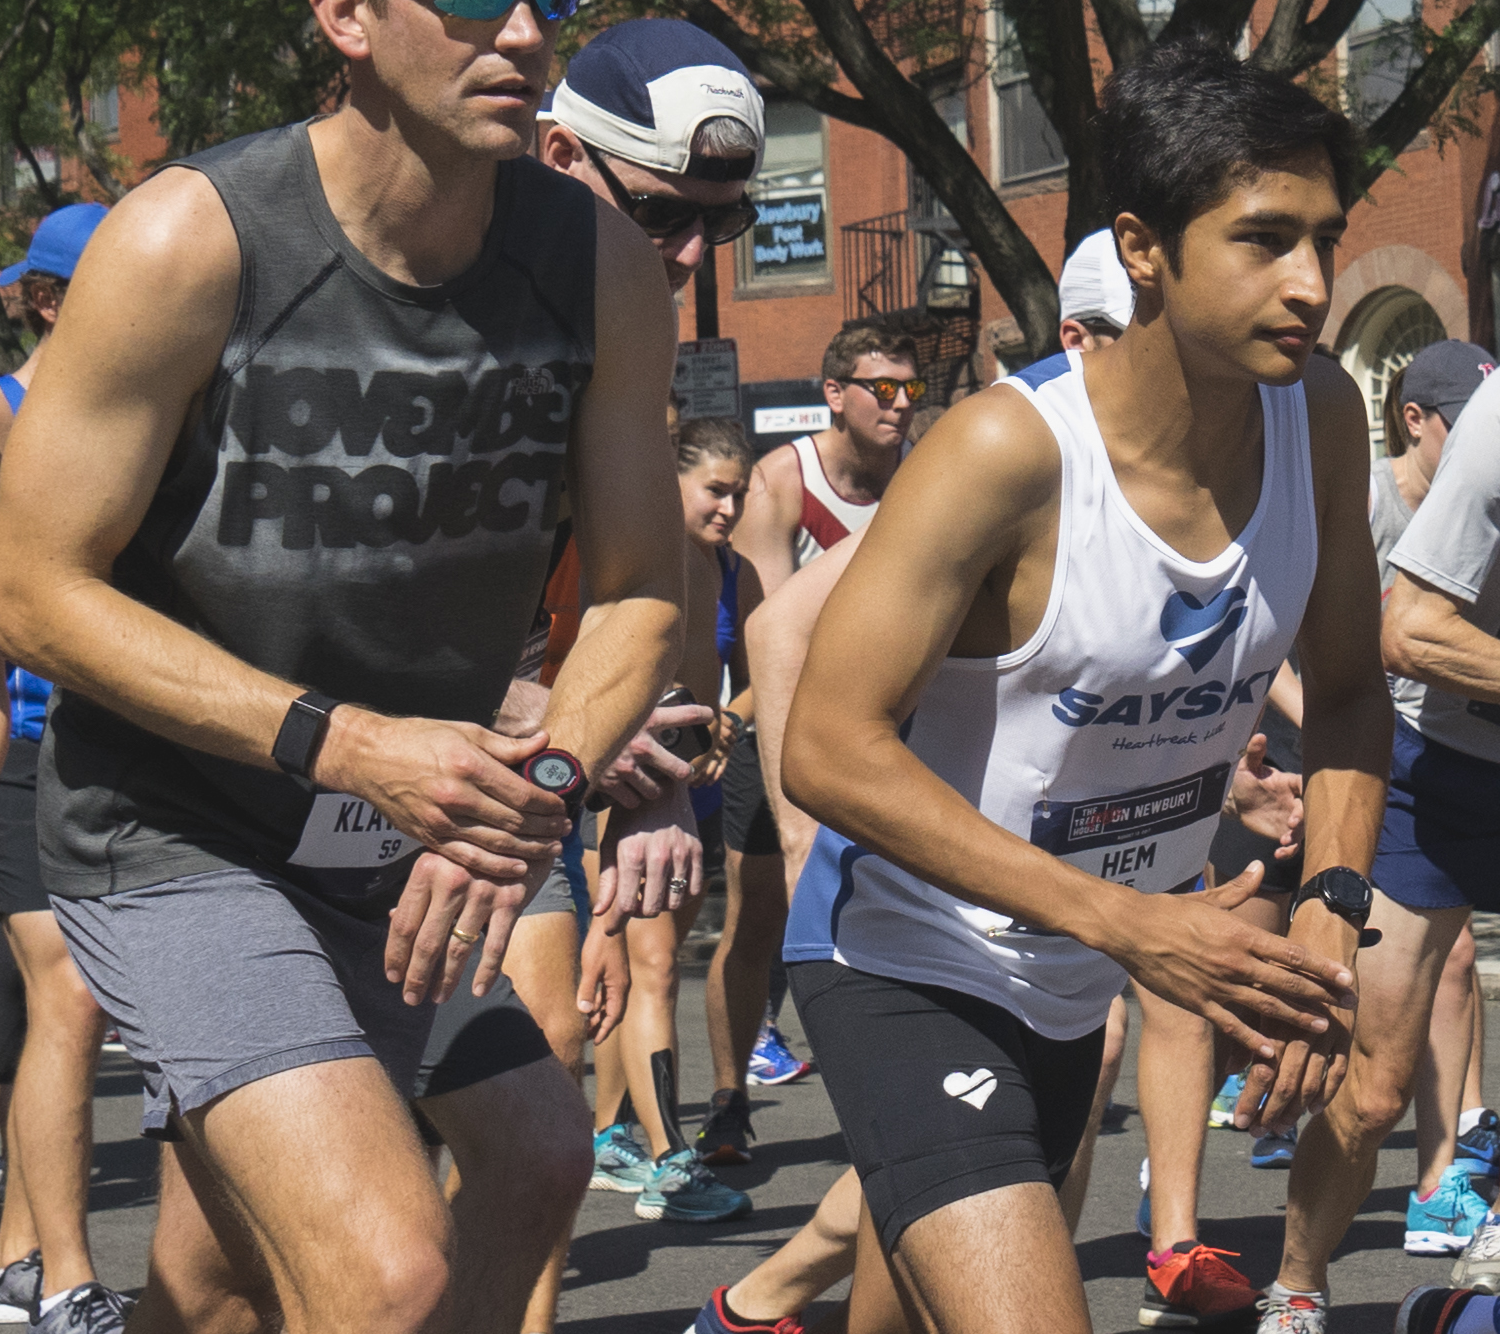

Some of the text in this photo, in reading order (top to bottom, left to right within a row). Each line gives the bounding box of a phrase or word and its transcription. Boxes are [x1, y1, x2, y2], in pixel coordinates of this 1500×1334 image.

[222, 363, 571, 458] NOVEMBE
[1111, 731, 1198, 751] Heartbreak
[333, 800, 399, 834] KLA
[1082, 806, 1099, 817] THE
[1111, 789, 1195, 823] ON NEWBURY
[377, 839, 402, 860] 59
[1100, 841, 1158, 879] HEM
